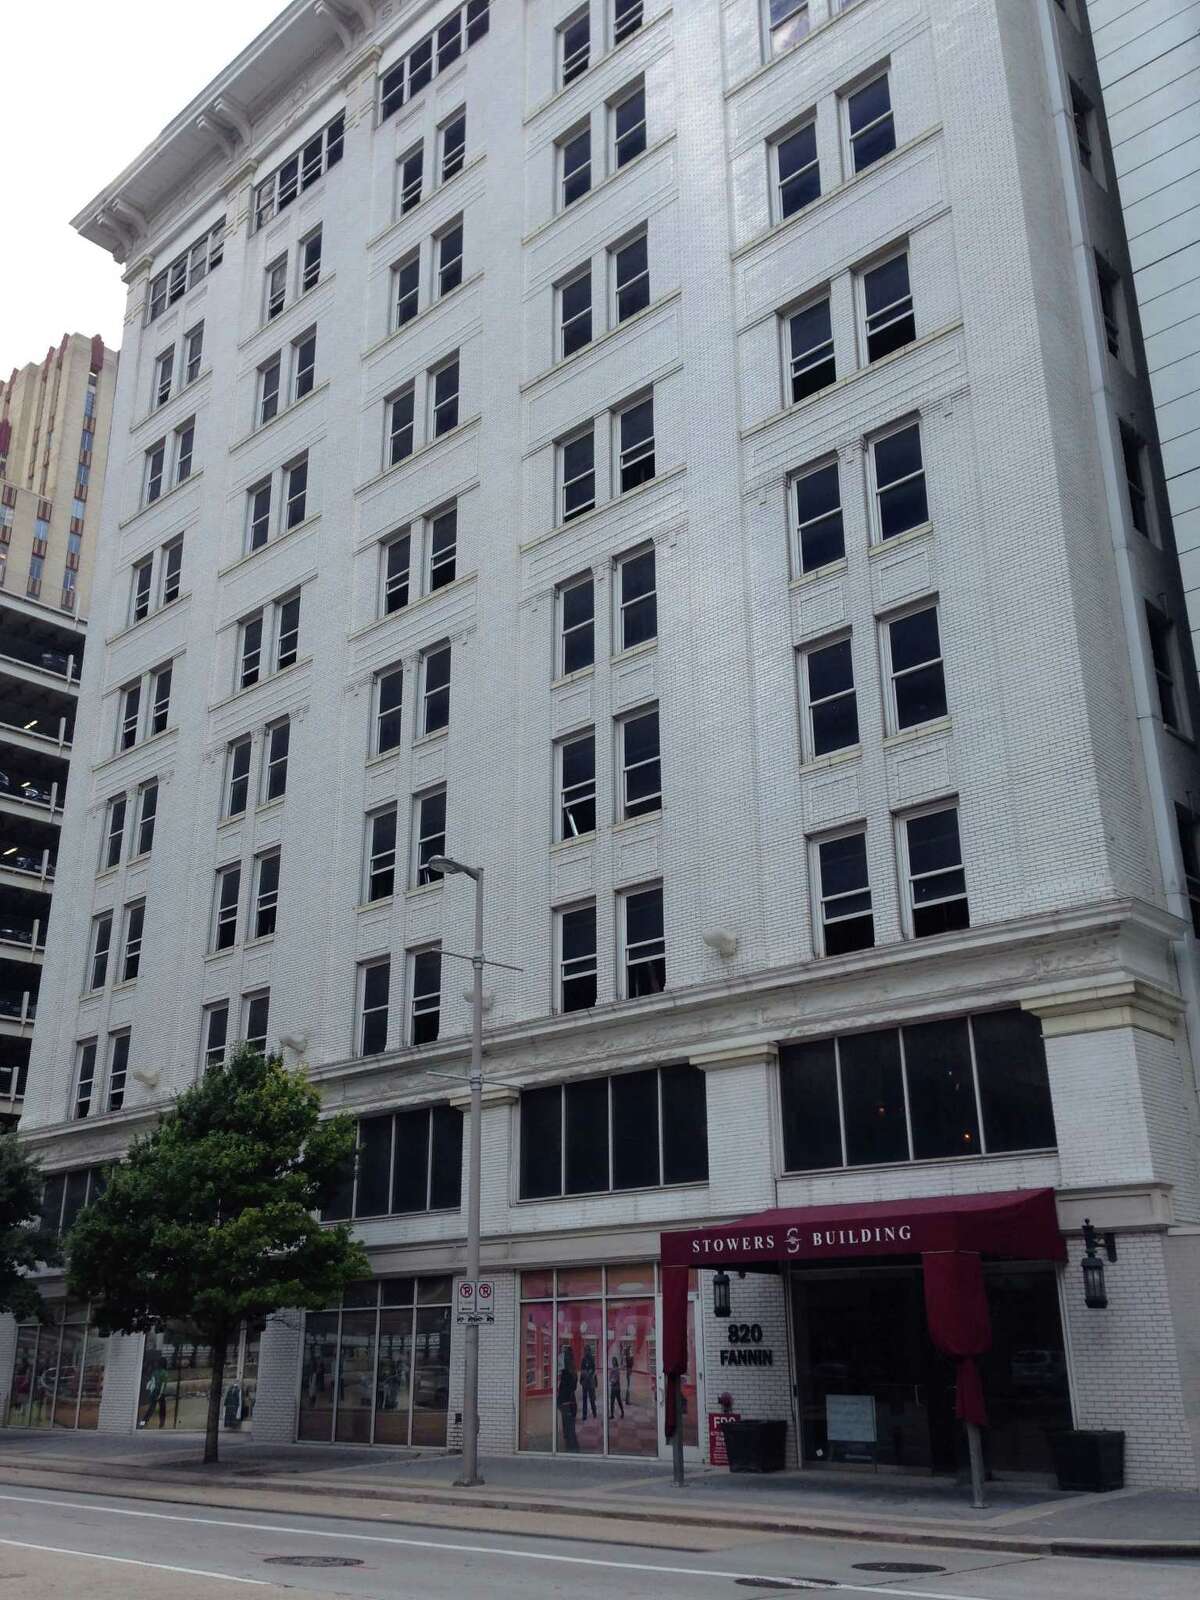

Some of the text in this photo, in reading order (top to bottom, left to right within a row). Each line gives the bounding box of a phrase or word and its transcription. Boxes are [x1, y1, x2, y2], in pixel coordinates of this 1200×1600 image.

[692, 1235, 775, 1253] STOWERS
[813, 1225, 912, 1246] BUILDING
[728, 1323, 763, 1344] 820
[720, 1349, 773, 1366] FANNIN
